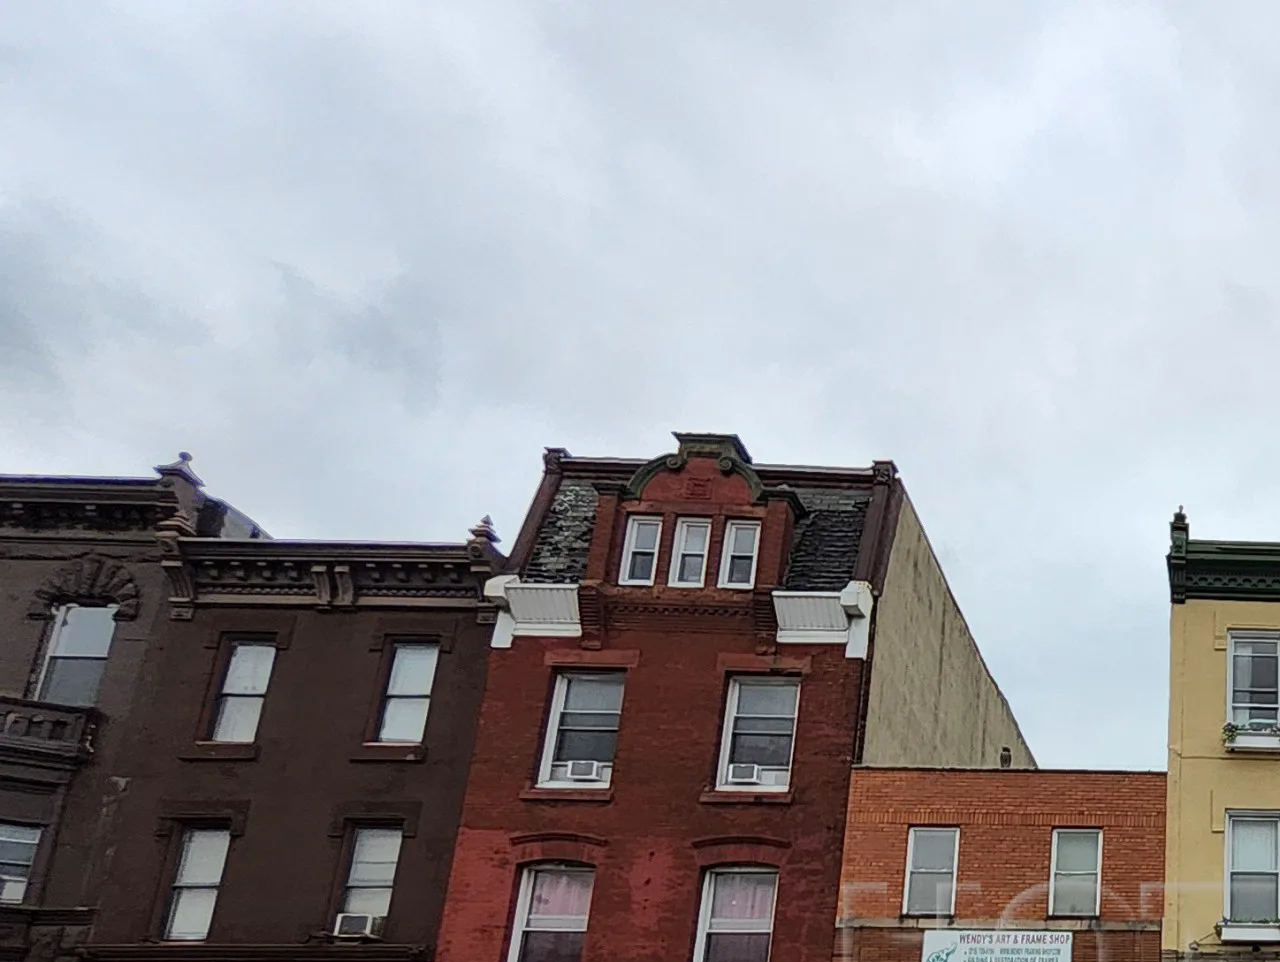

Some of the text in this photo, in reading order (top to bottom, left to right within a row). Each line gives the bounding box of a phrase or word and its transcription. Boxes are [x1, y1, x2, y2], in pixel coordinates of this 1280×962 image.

[959, 934, 1070, 944] WENDY'S ART & FRAME SHOP
